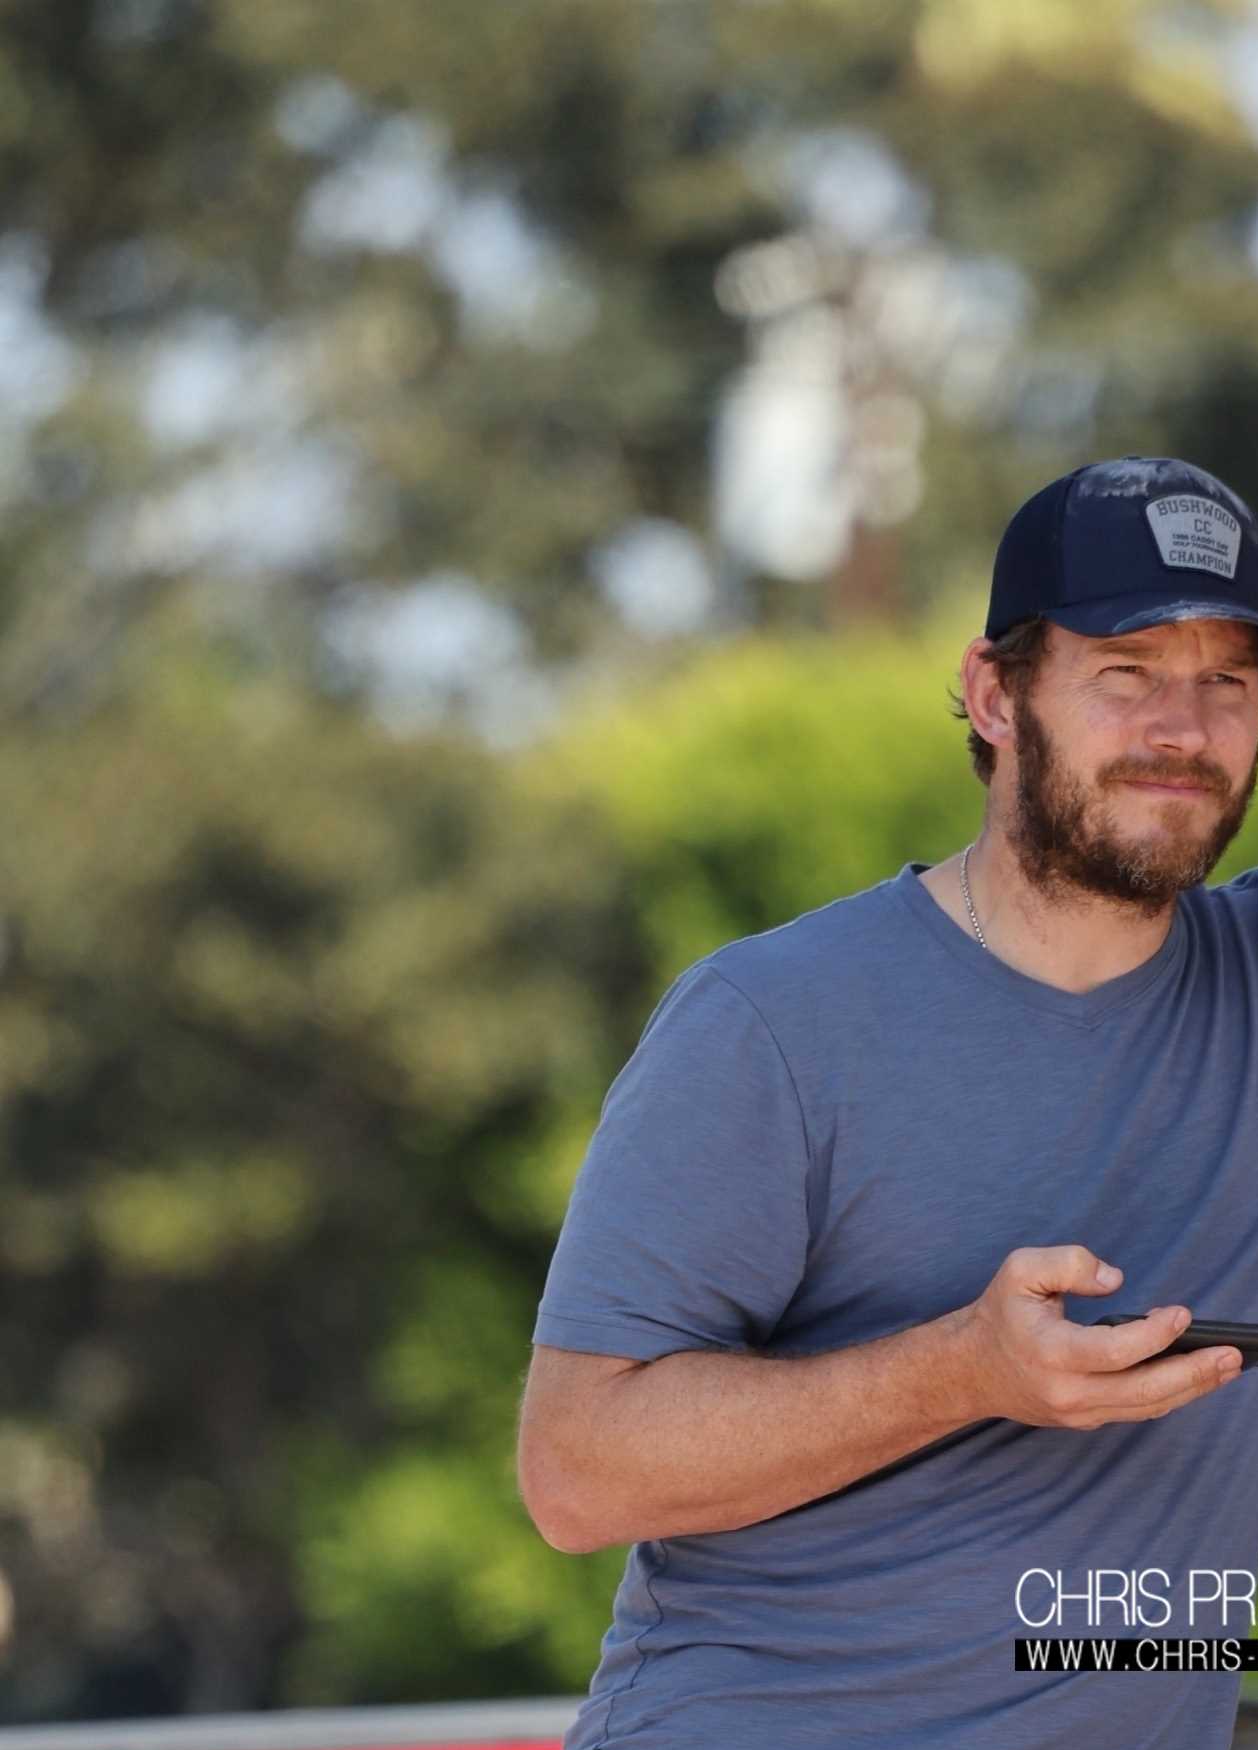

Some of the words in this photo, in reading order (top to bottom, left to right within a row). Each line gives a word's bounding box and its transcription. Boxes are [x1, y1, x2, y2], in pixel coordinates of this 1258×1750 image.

[1156, 499, 1237, 532] BUSHWOOD
[1194, 519, 1213, 535] CC
[1168, 550, 1232, 574] CHAMPION
